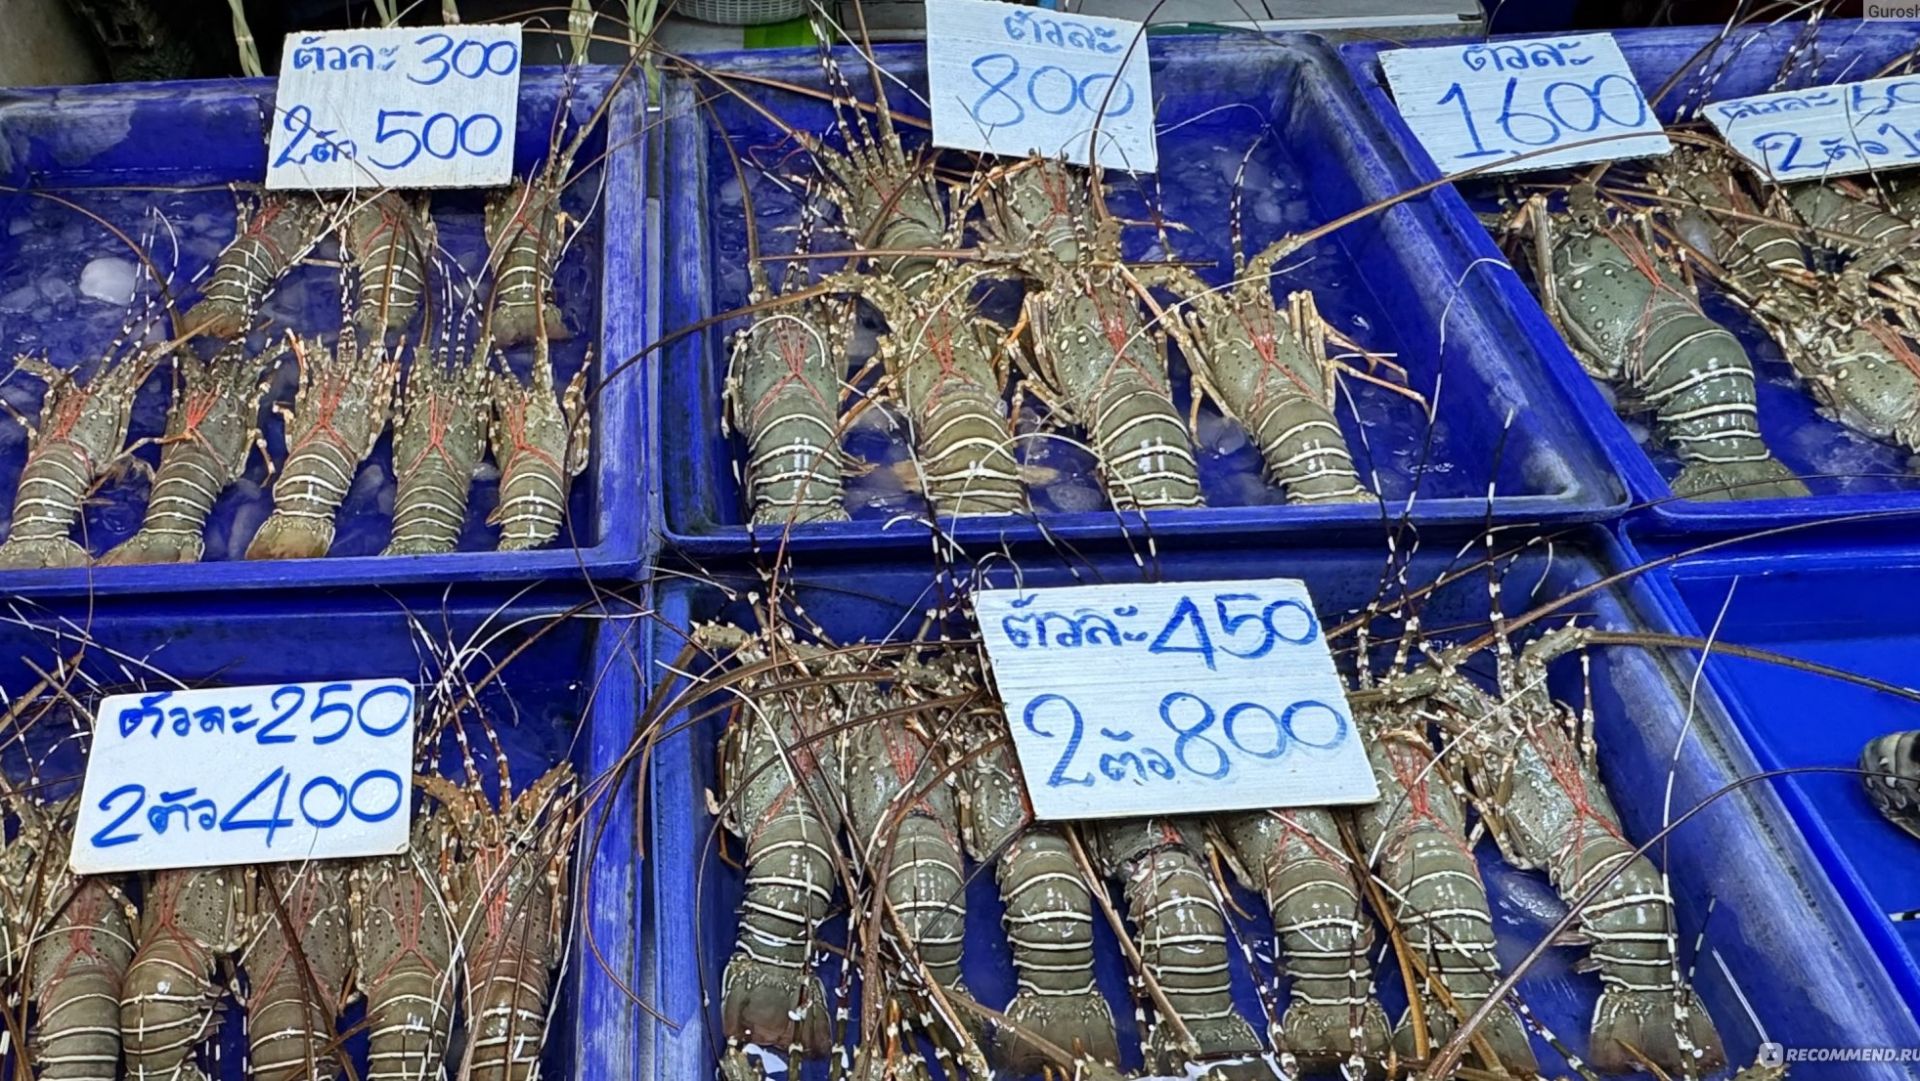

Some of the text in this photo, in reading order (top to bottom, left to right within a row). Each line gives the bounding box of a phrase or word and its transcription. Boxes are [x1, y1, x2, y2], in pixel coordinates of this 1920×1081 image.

[293, 33, 519, 85] ตัวละ 300
[1004, 10, 1122, 53] ตัวละ
[971, 53, 1134, 127] 800
[1437, 75, 1647, 158] 1600
[368, 109, 502, 170] 500
[1002, 593, 1319, 671] ตัวละ 450
[256, 684, 413, 745] 250
[1159, 692, 1348, 780] 800
[219, 766, 404, 848] 400
